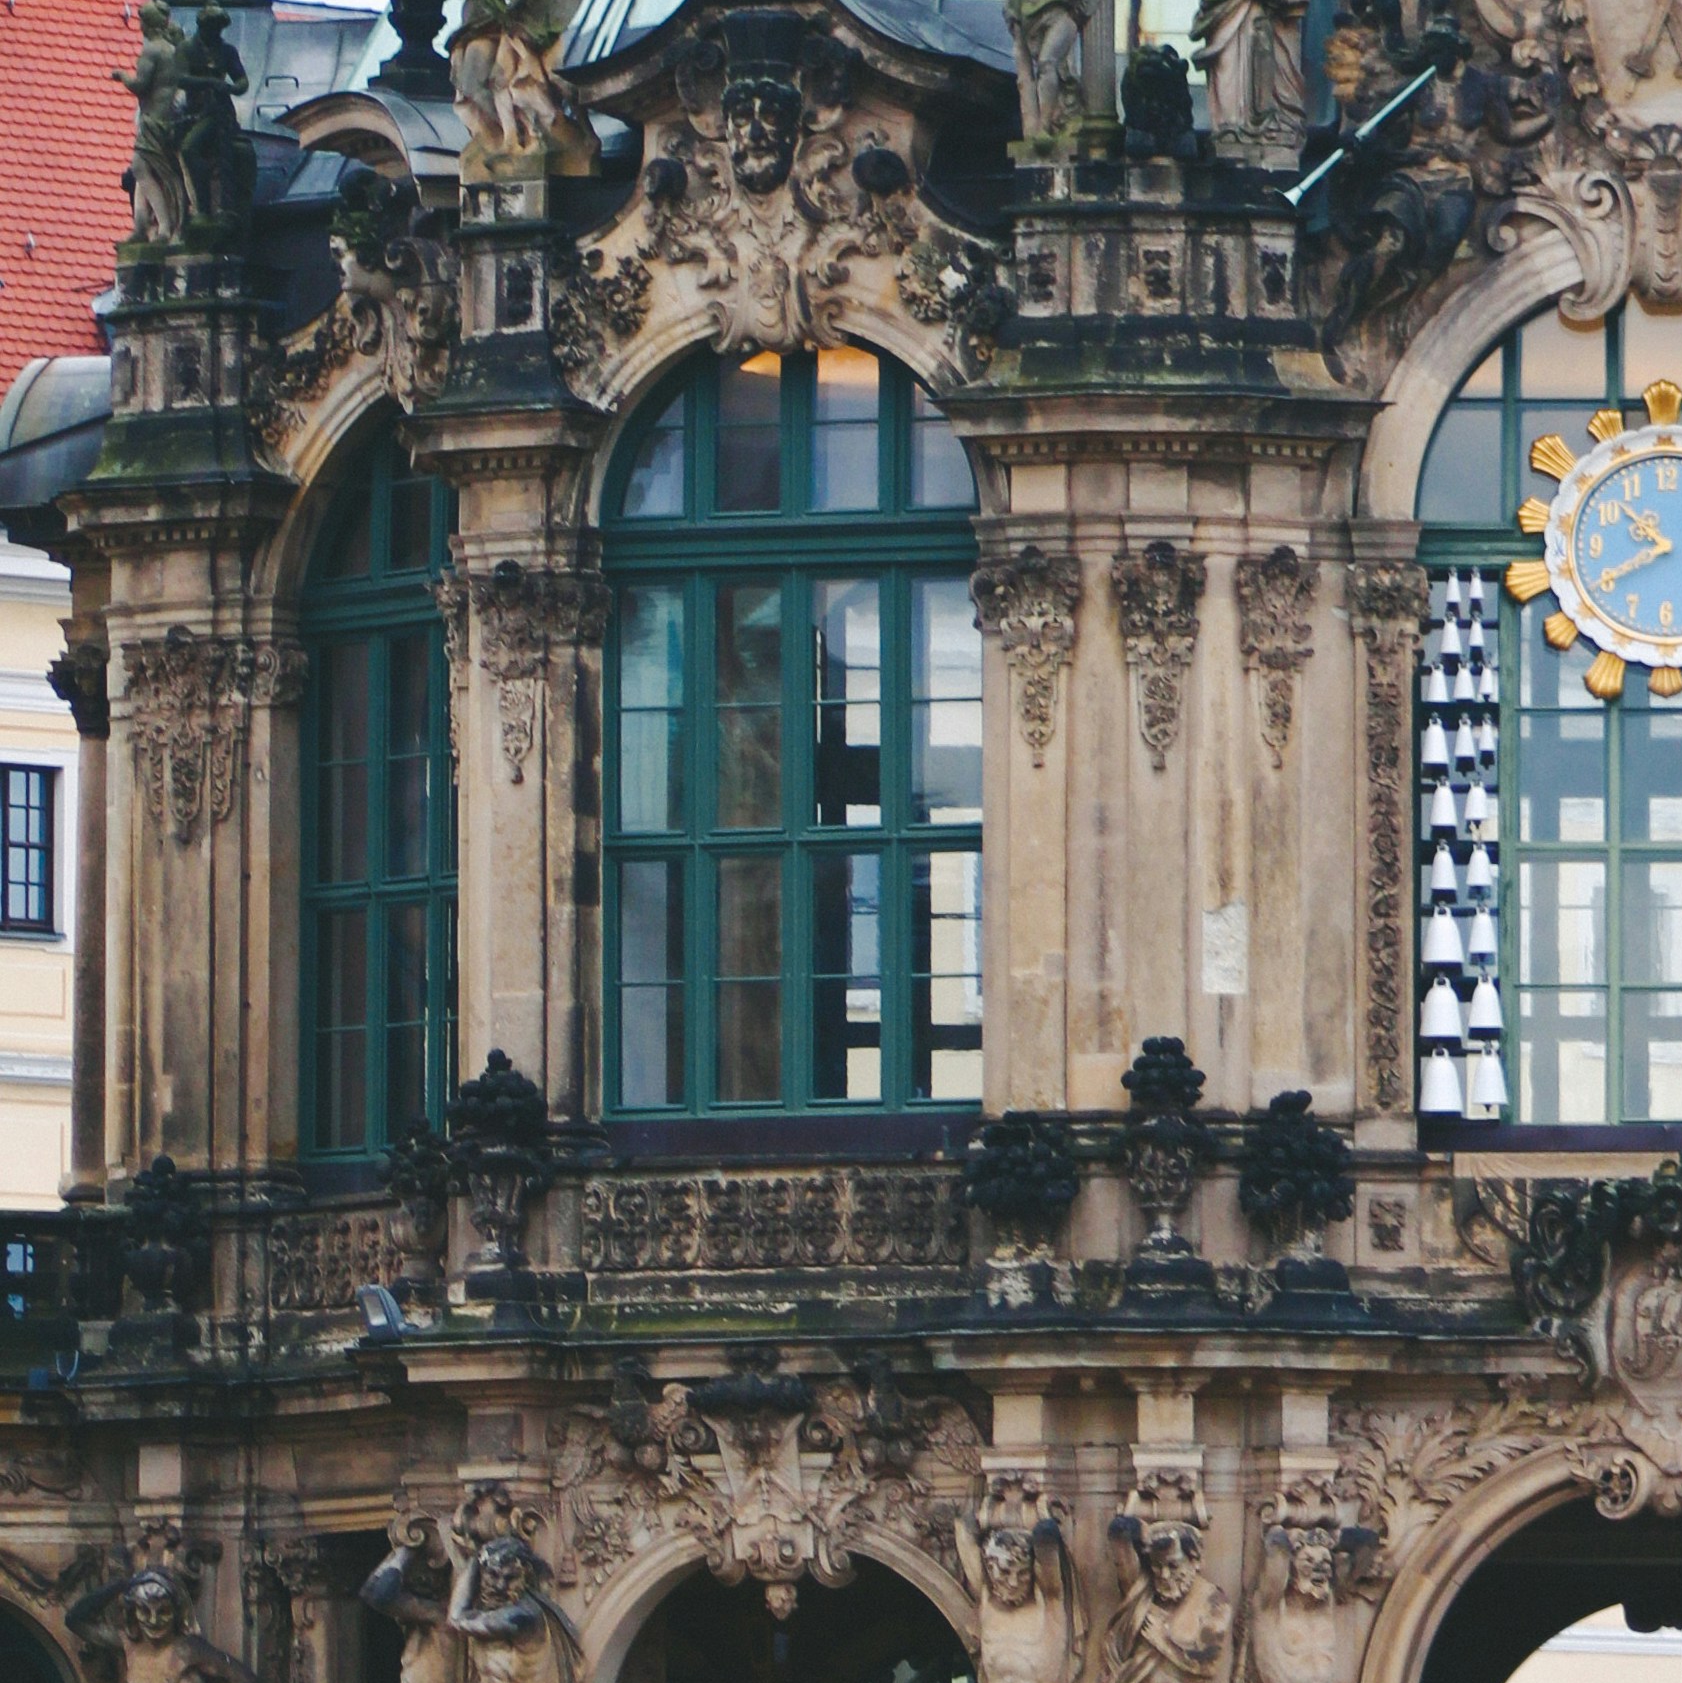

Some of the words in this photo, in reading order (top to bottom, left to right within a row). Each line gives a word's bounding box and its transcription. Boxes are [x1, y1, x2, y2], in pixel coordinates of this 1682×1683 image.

[1623, 473, 1641, 501] 11
[1656, 466, 1678, 492] 12
[1599, 500, 1619, 526] 10
[1589, 533, 1603, 559] 9
[1626, 593, 1639, 619] 7
[1659, 600, 1673, 626] 6
